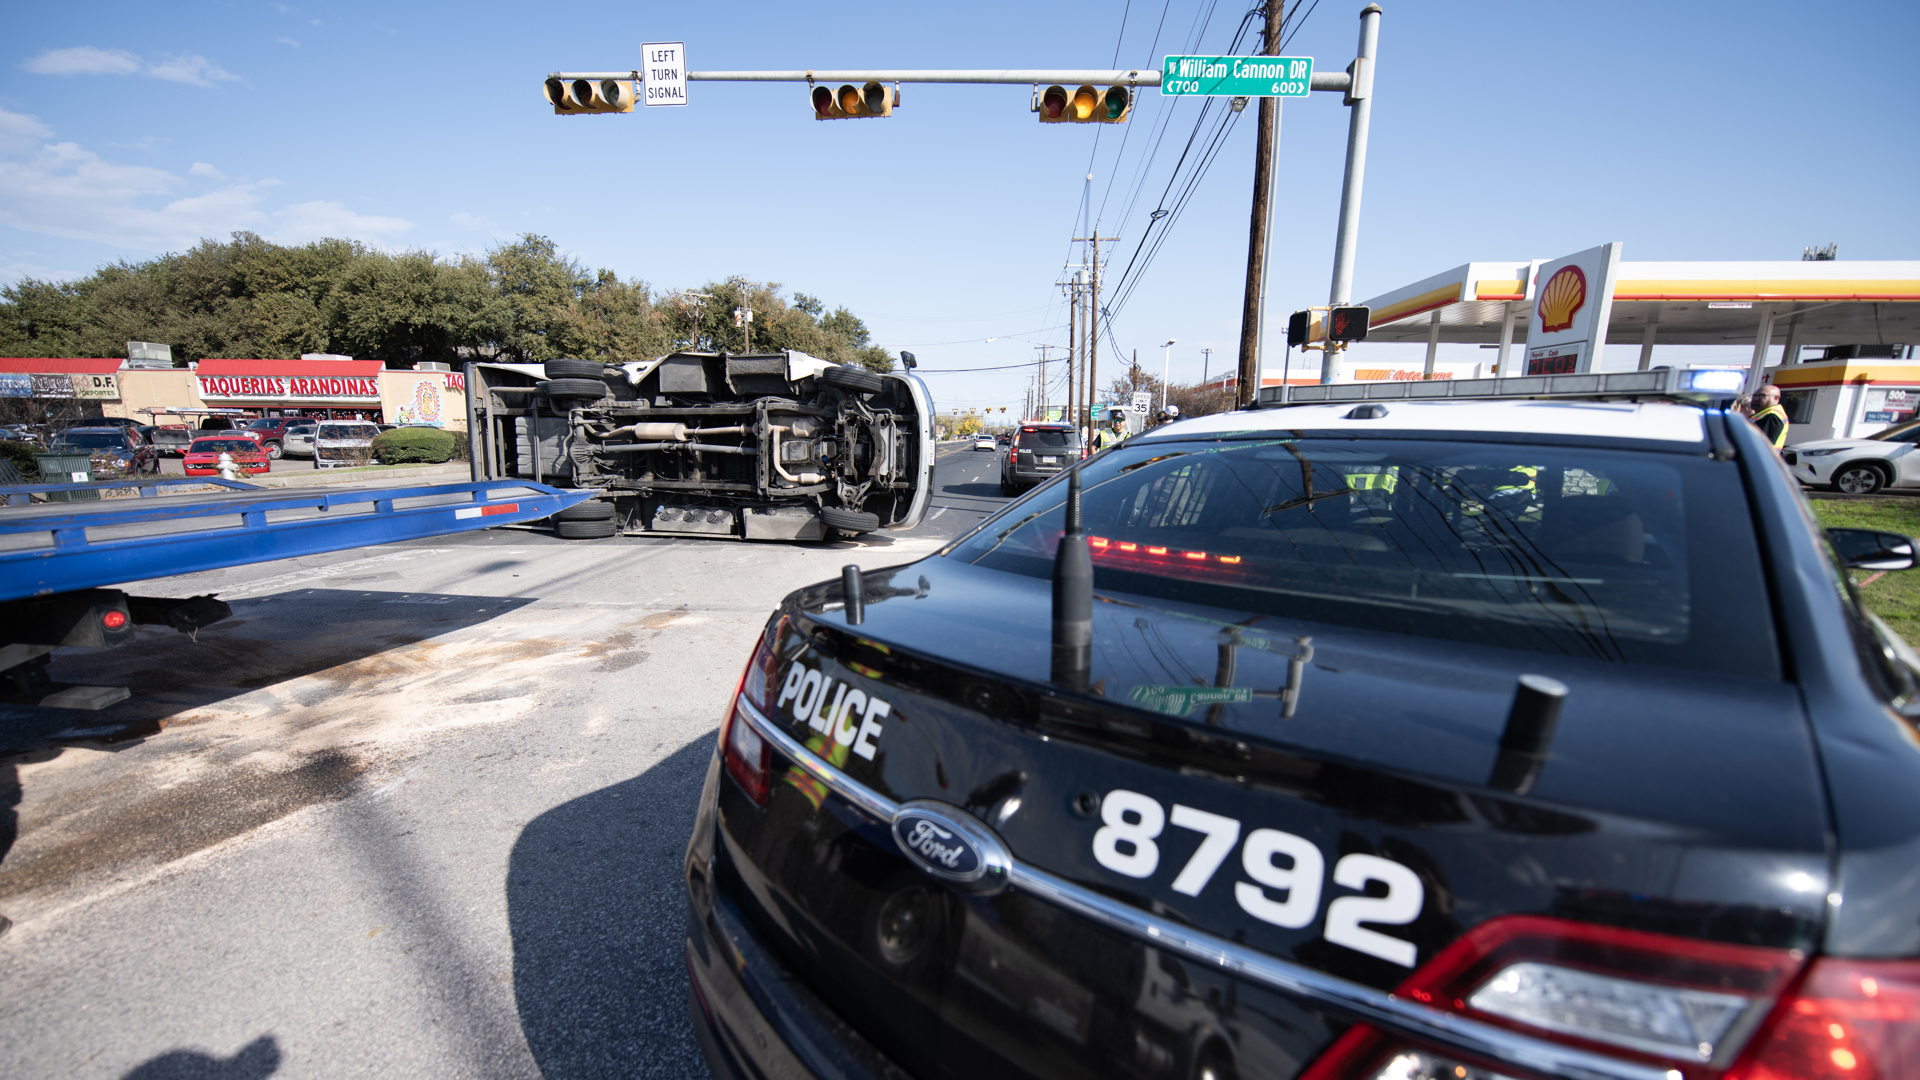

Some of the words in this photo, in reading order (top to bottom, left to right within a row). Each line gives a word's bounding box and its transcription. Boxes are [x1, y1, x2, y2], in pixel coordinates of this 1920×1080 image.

[651, 50, 675, 62] LEFT
[651, 68, 678, 81] TURN
[1169, 61, 1176, 74] W
[1179, 59, 1227, 78] William
[1233, 59, 1284, 79] Cannon
[1290, 60, 1308, 79] DR
[648, 86, 685, 99] SIGNAL
[1175, 80, 1199, 92] 700
[1271, 82, 1297, 94] 600
[1548, 349, 1559, 357] Cash
[1392, 369, 1454, 381] Autoone
[93, 377, 114, 388] D.F.
[200, 377, 285, 397] TAQUERIAS
[290, 378, 378, 395] ARANDINAS
[445, 374, 465, 391] TAQ
[1888, 390, 1906, 400] 500
[1134, 403, 1147, 412] 35
[777, 661, 891, 761] POLICE
[907, 819, 964, 868] Ford
[1092, 789, 1425, 969] 8792
